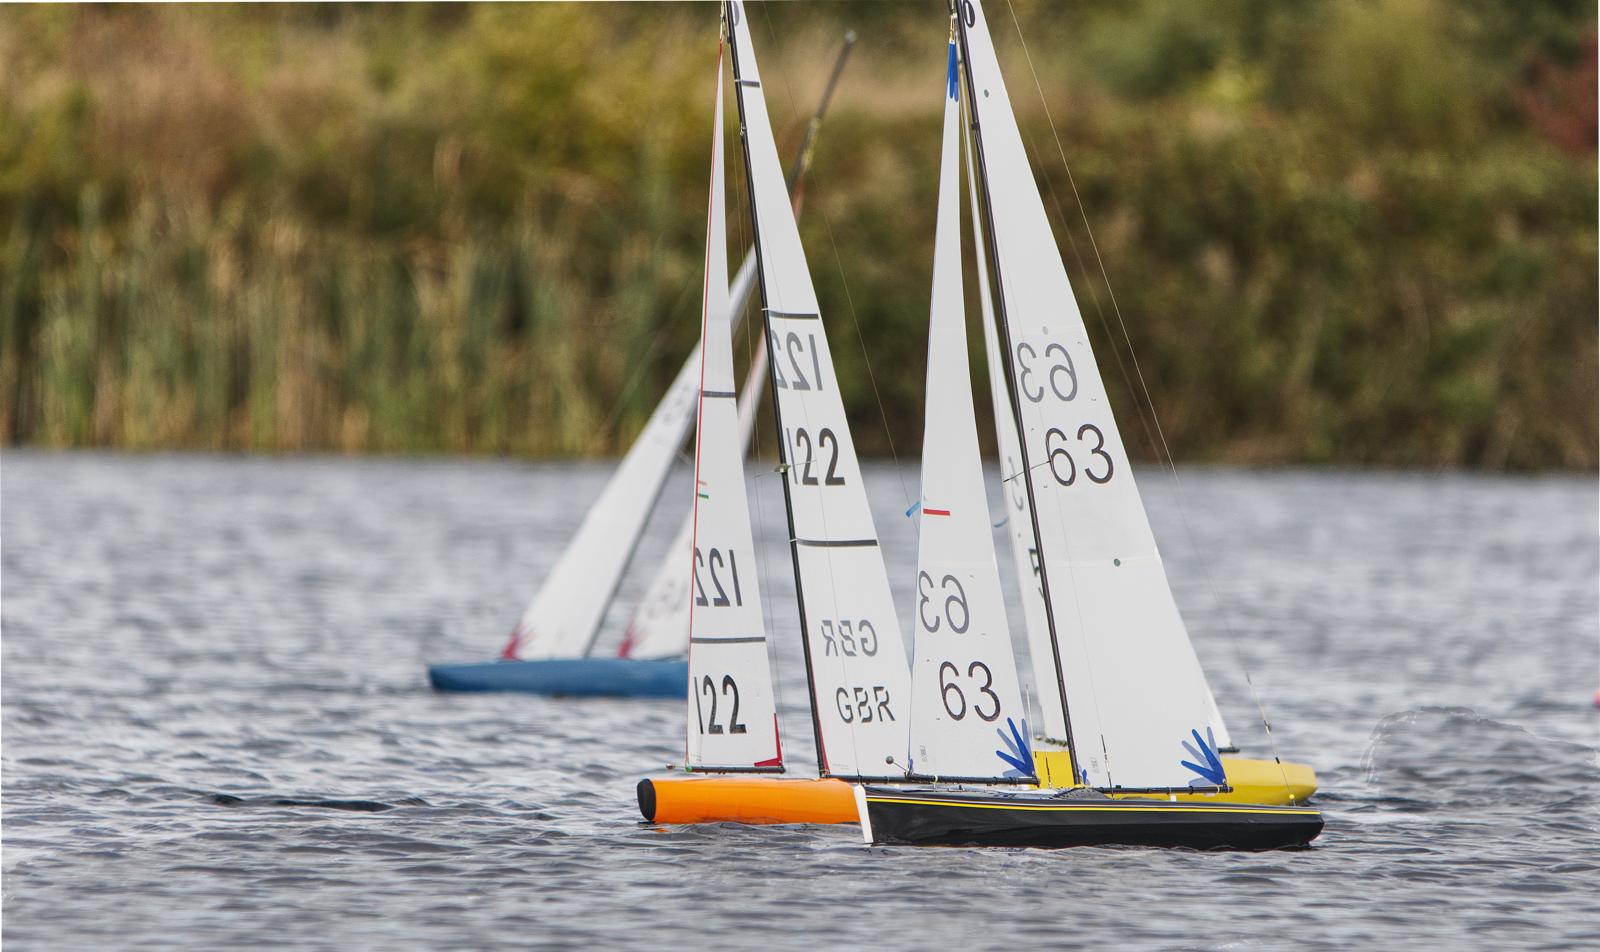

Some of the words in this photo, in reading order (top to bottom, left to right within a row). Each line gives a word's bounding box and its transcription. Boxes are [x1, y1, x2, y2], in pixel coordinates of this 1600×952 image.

[786, 428, 845, 485] 122
[1045, 423, 1114, 487] 63
[694, 675, 747, 734] 122
[836, 686, 896, 724] GBR
[939, 661, 1000, 722] 63
